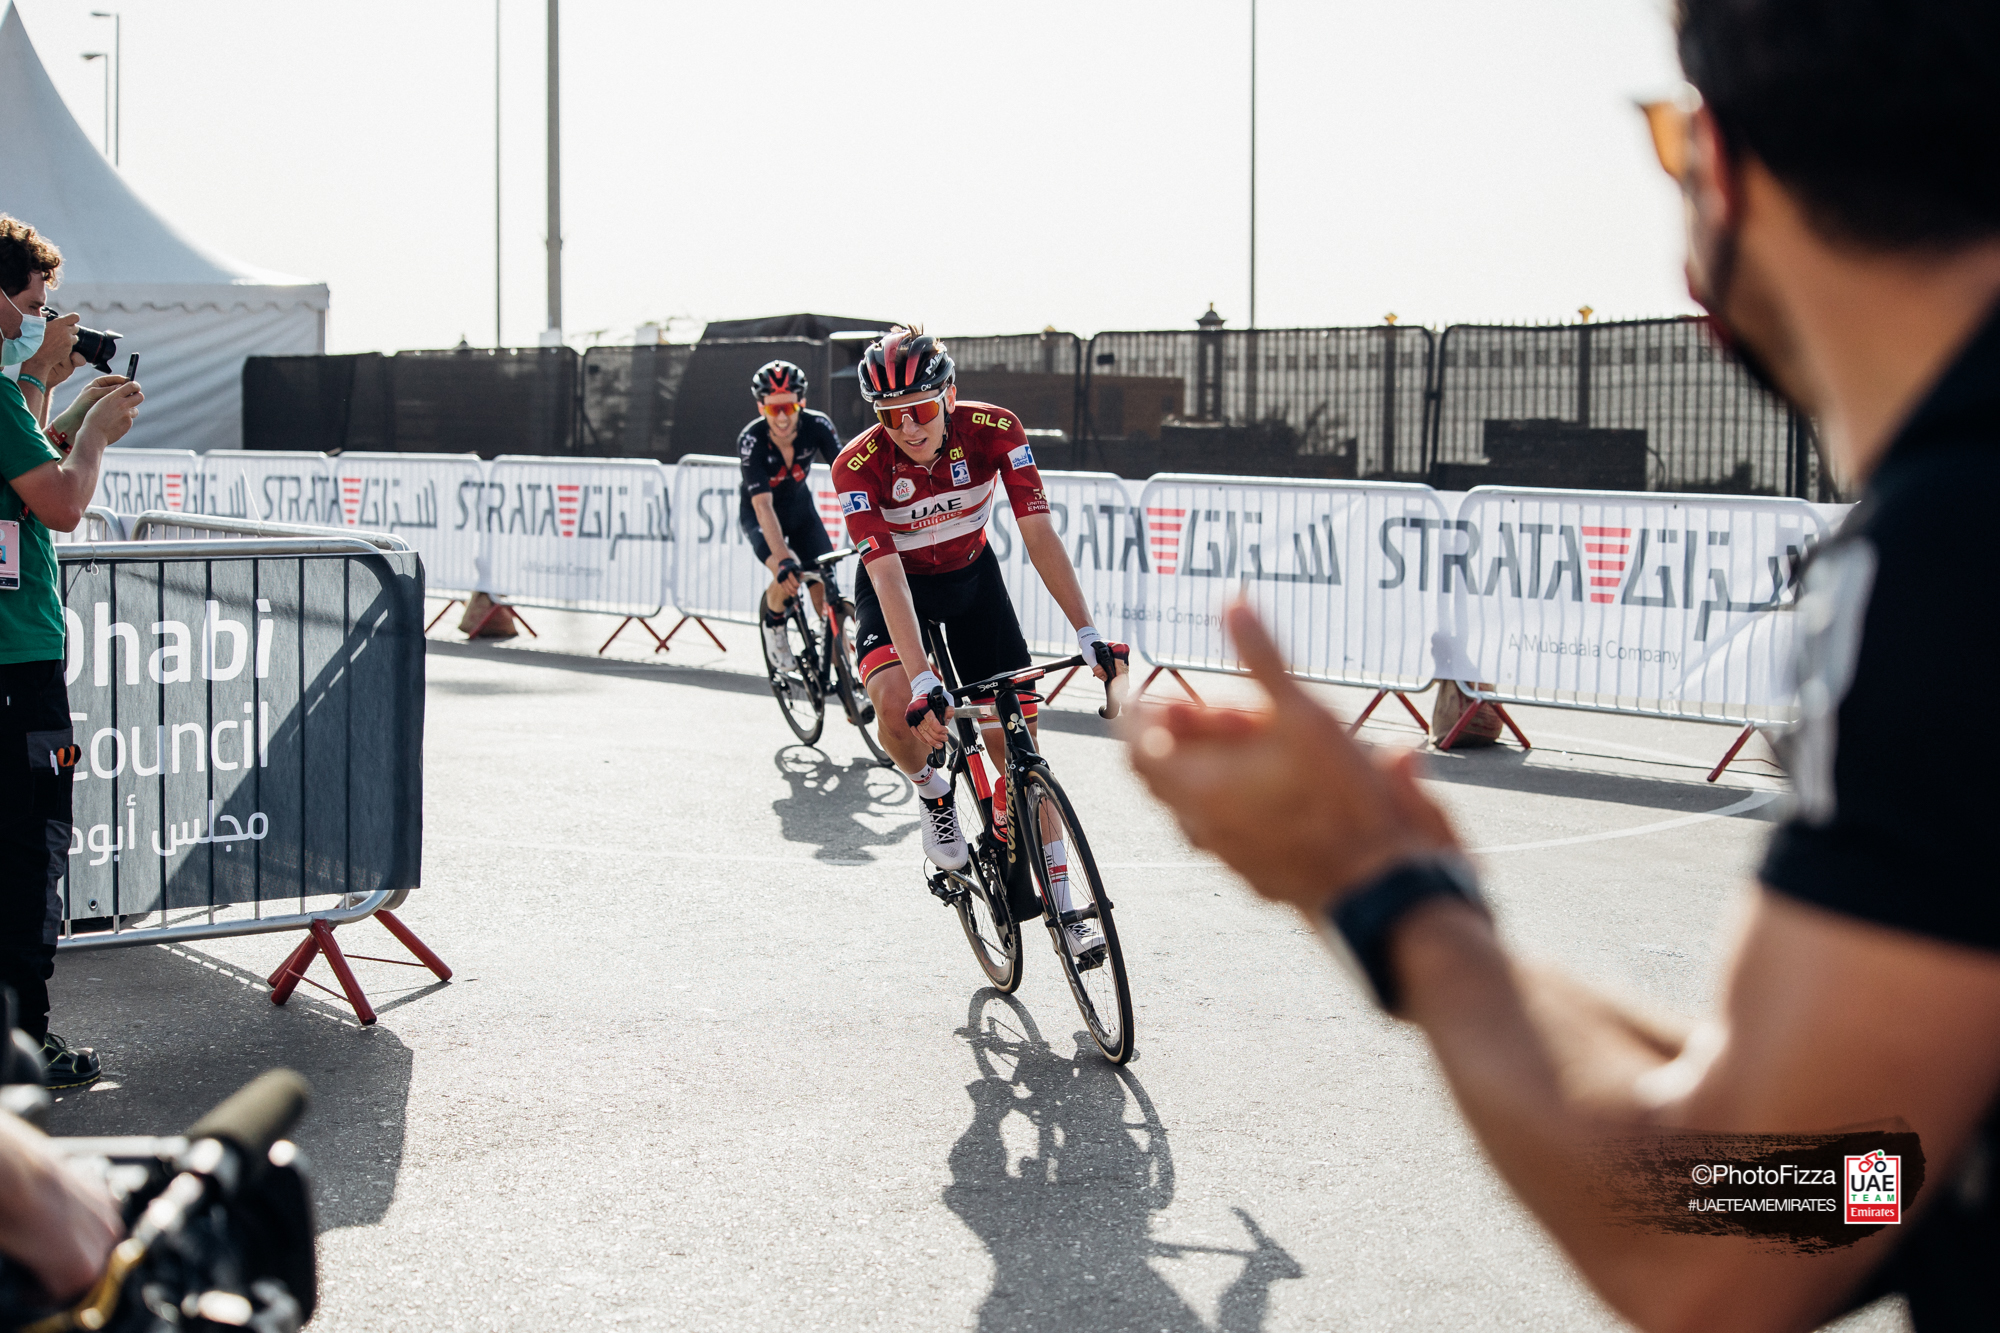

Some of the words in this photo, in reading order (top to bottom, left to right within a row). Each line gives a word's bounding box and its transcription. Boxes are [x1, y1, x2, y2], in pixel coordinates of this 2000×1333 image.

[103, 471, 168, 514] STRATA
[264, 475, 343, 524] STRATA
[455, 481, 558, 537] STRATA
[895, 487, 910, 496] UAE
[911, 497, 963, 519] UAE
[910, 511, 963, 530] Emirates
[992, 503, 1150, 574] SATA
[1378, 517, 1583, 603] STRATA
[1093, 602, 1103, 618] A
[1106, 602, 1162, 622] Mubadala
[1166, 606, 1224, 632] Company
[1508, 633, 1520, 651] A
[1524, 634, 1600, 658] Mubadala
[1605, 639, 1682, 670] Company
[68, 794, 137, 866] أبو
[152, 799, 269, 857] مجلس
